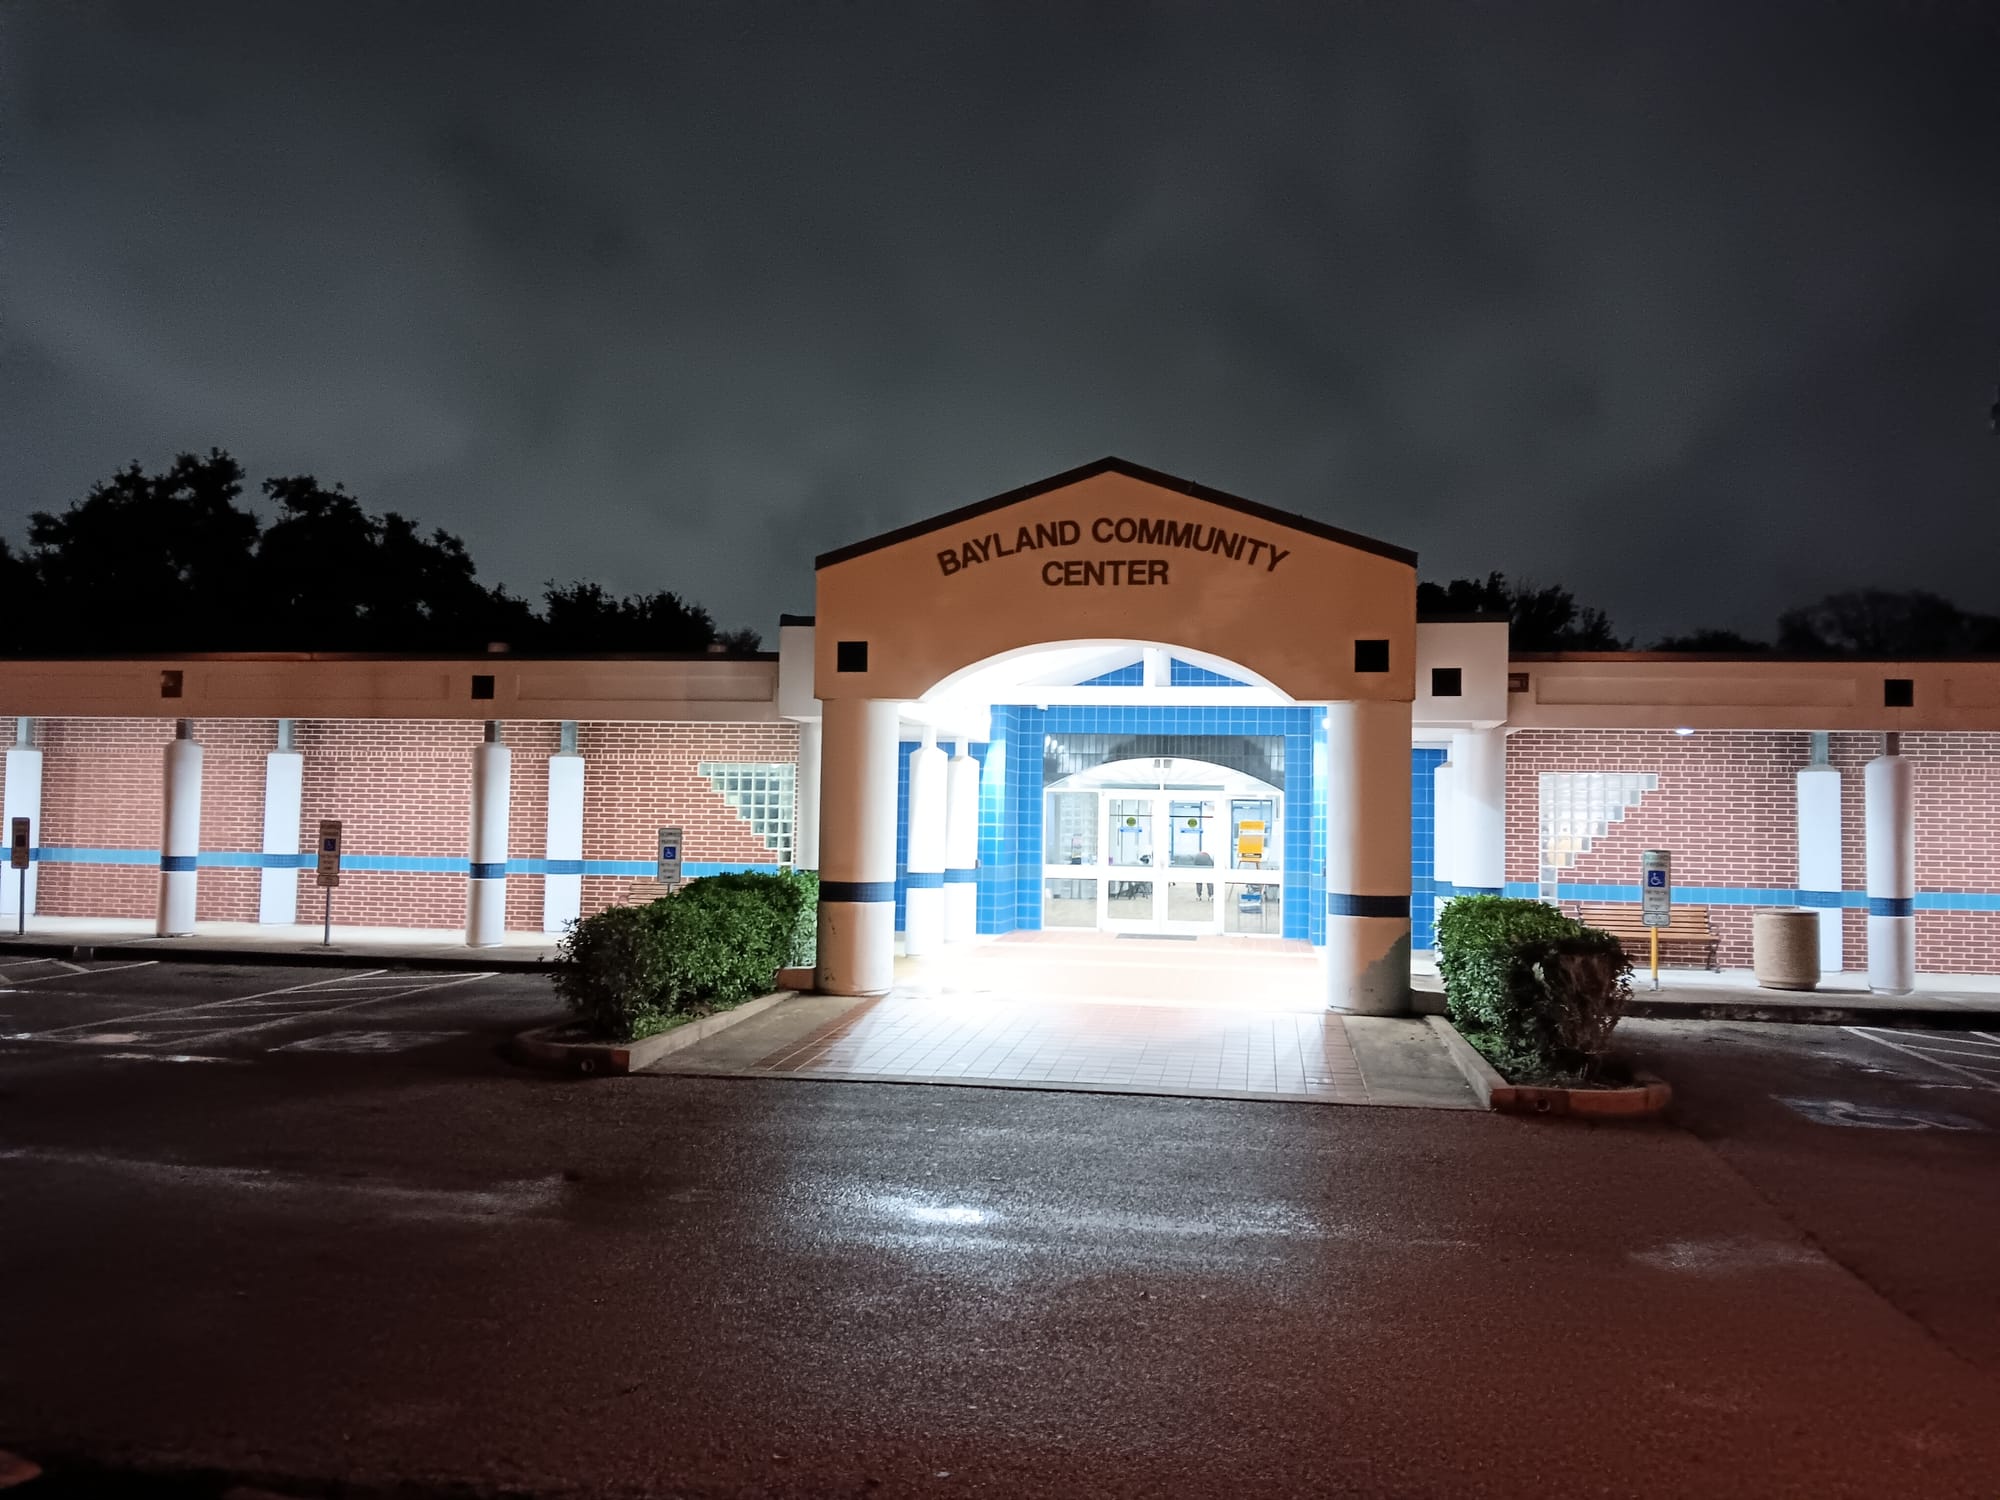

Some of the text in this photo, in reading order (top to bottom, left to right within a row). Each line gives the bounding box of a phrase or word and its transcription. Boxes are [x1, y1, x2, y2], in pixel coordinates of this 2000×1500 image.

[937, 518, 1290, 576] BAYLAND COMMUNITY
[1042, 560, 1169, 586] CENTER
